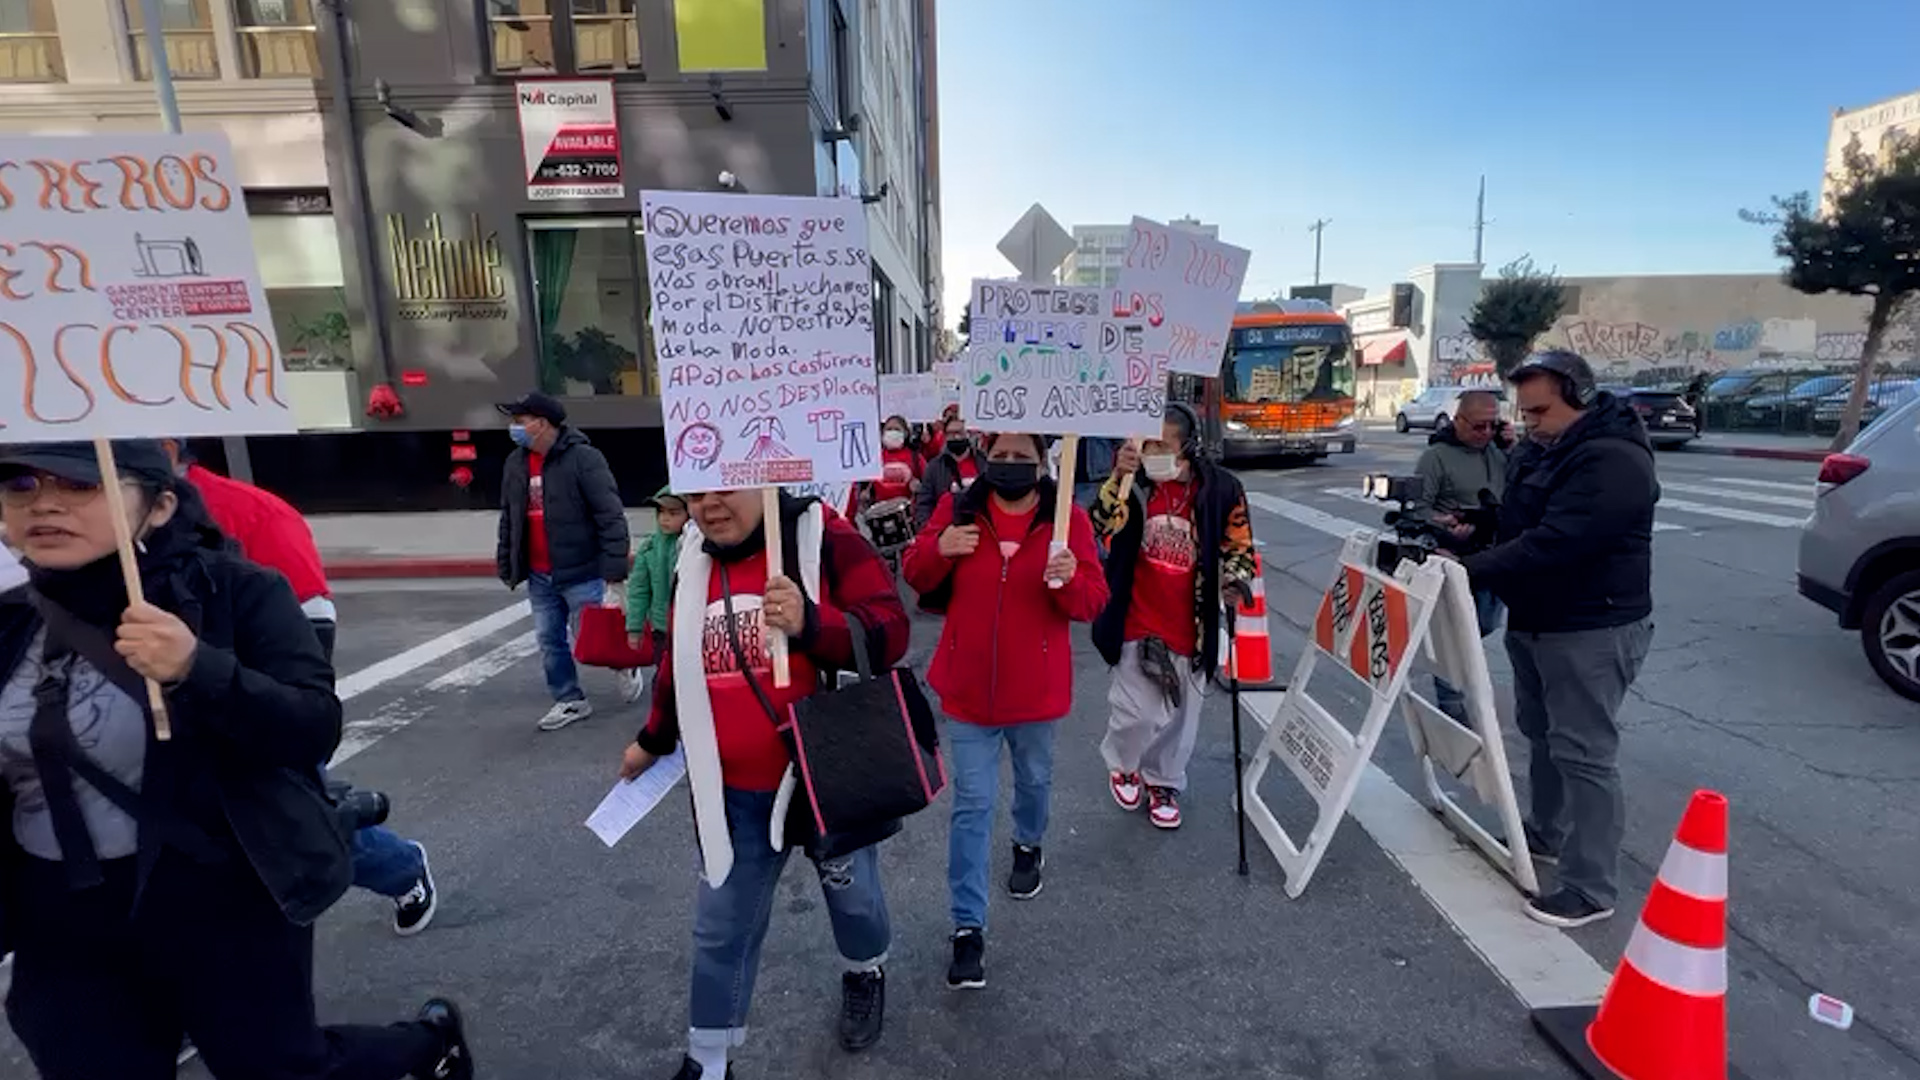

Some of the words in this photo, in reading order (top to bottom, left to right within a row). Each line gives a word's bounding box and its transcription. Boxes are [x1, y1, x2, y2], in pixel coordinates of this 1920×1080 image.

[548, 92, 598, 107] Capital
[554, 135, 616, 151] AVAILABLE
[105, 284, 178, 296] GARMENT
[109, 295, 182, 307] WORKER
[113, 306, 182, 320] CENTER
[979, 285, 1099, 318] PROTEGE
[1111, 291, 1164, 327] LOS
[738, 315, 773, 338] NO
[1099, 323, 1144, 354] DE
[0, 321, 288, 429] UCHA
[971, 346, 1116, 386] COSTURA
[1127, 355, 1170, 388] DE
[670, 397, 711, 422] NO
[720, 390, 772, 418] NOS
[975, 386, 1028, 420] LOS
[1042, 384, 1164, 417] ANGELES
